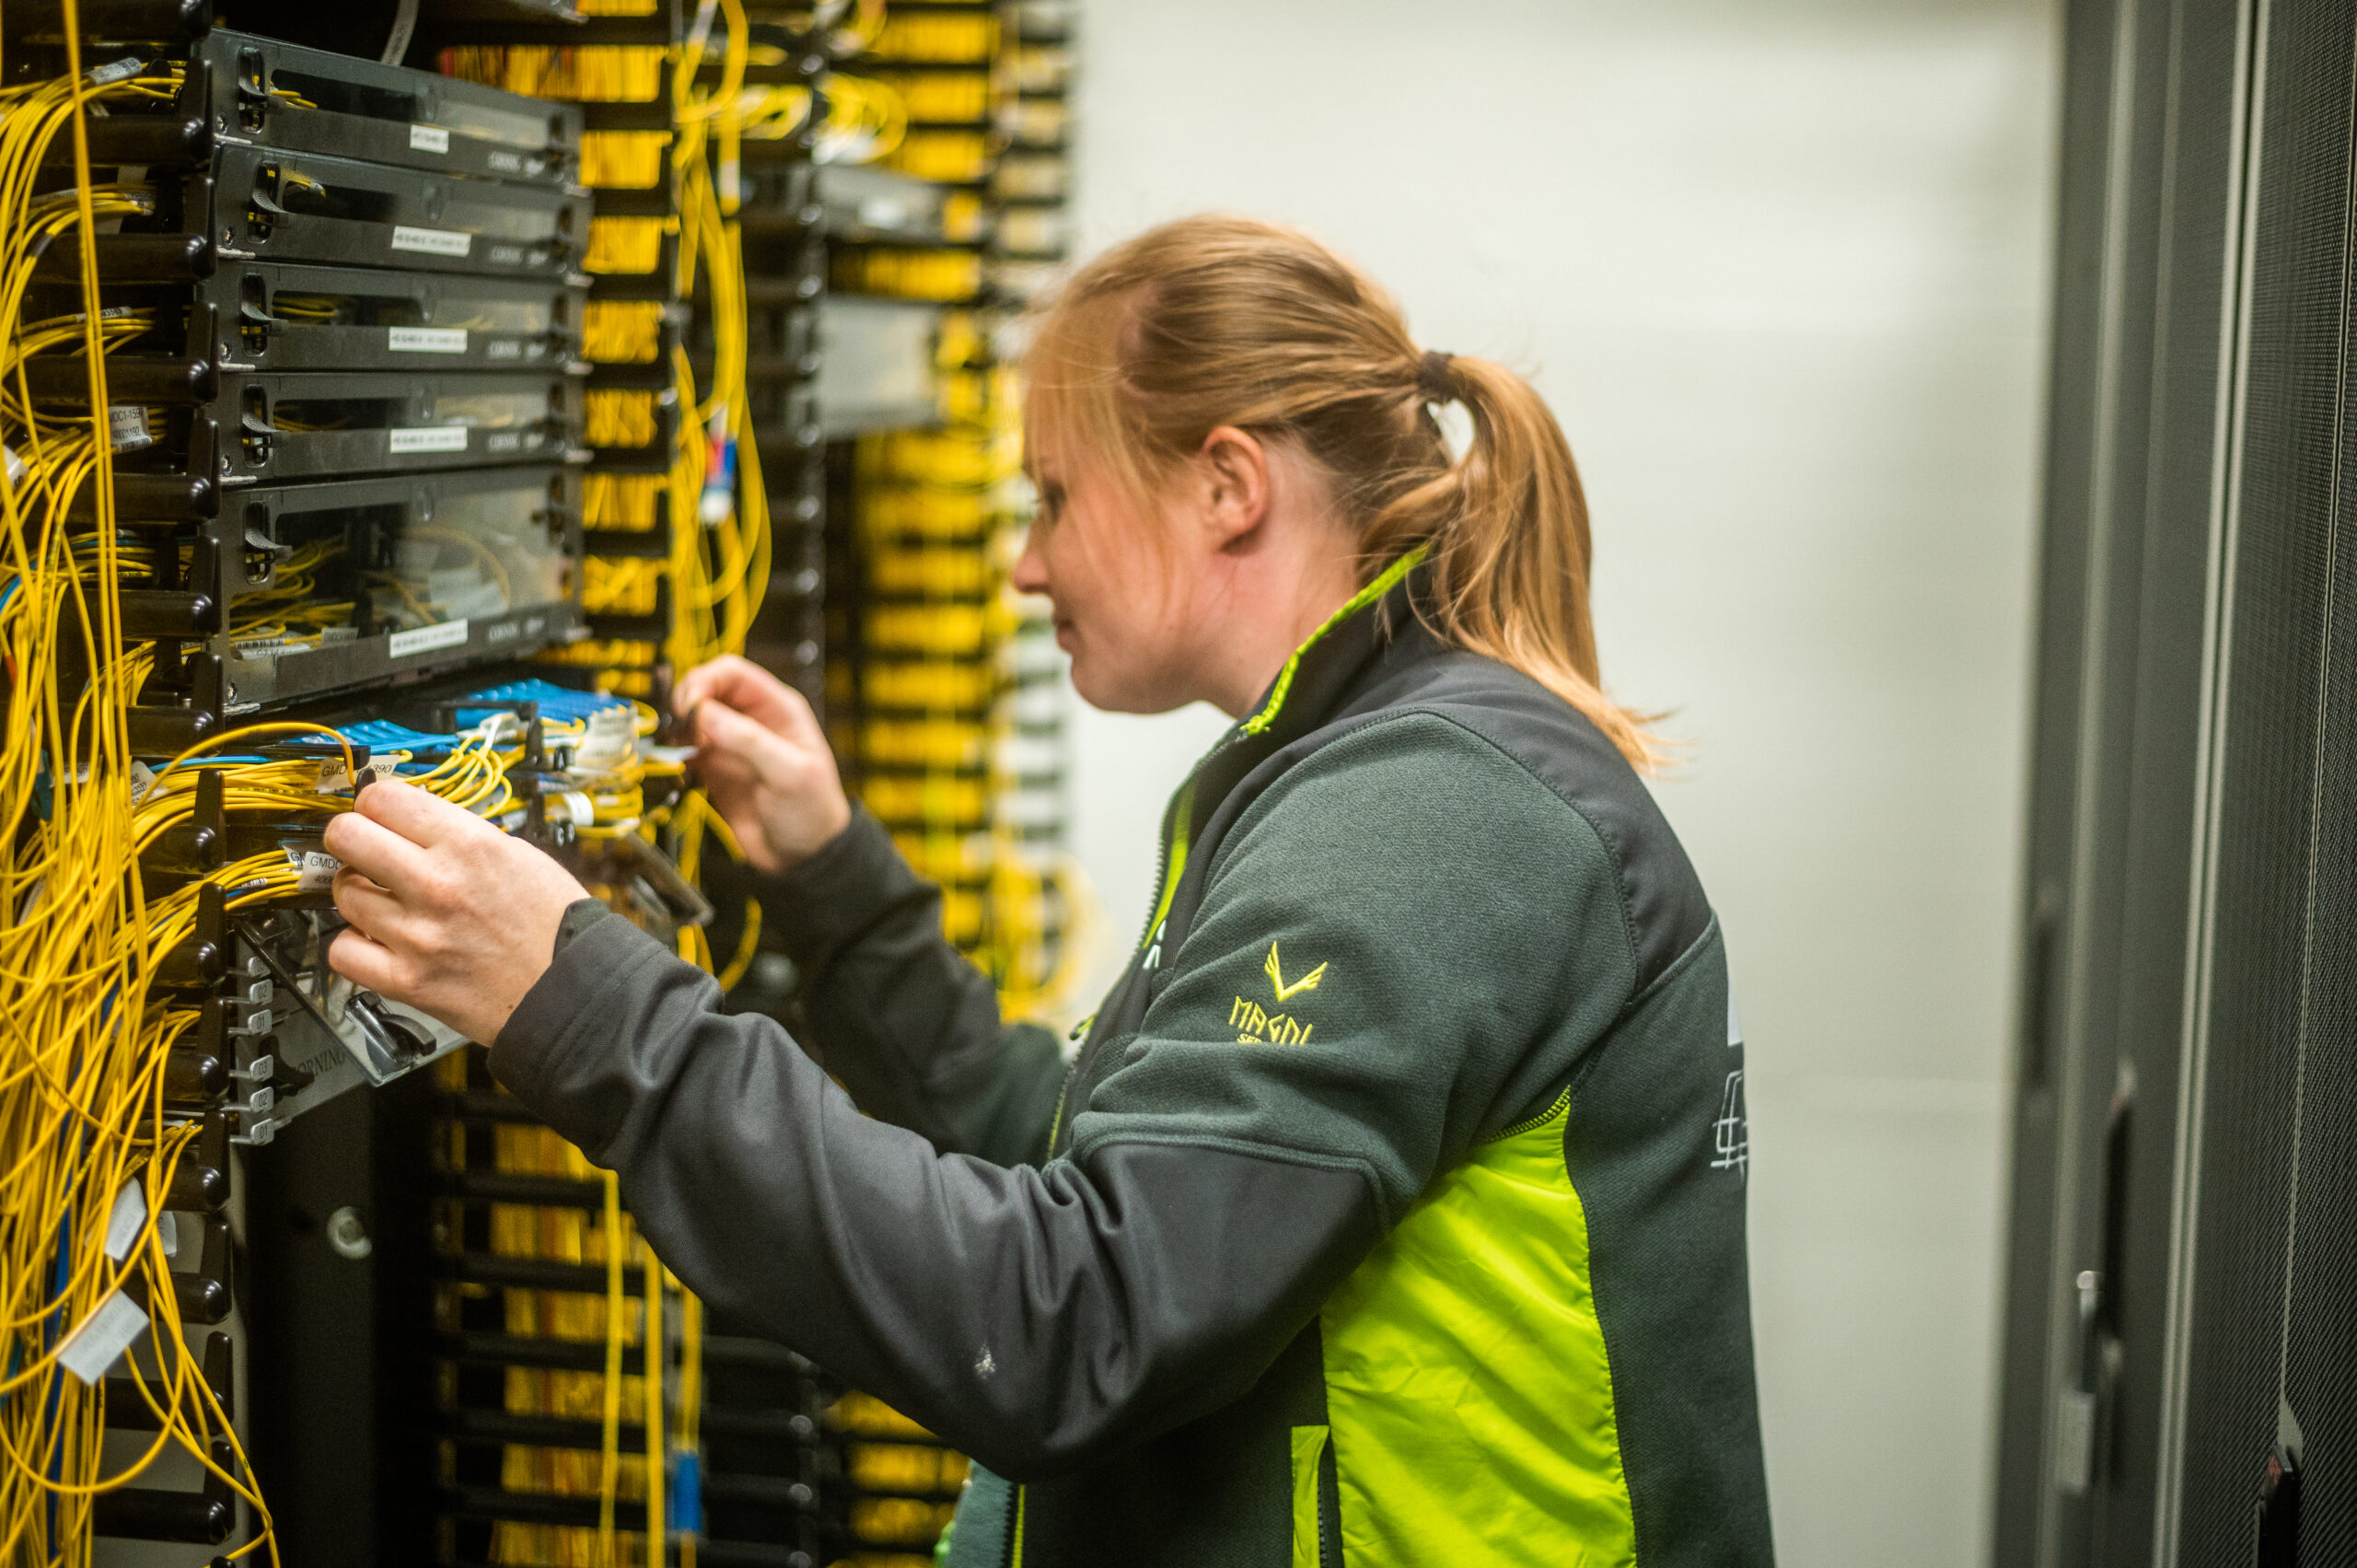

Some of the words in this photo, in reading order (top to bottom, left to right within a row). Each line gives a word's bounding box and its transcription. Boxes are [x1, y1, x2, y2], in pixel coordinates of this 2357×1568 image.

[258, 985, 268, 999] 02
[257, 1016, 265, 1030] 01
[258, 1061, 268, 1075] 03
[258, 1092, 268, 1107] 02
[259, 1124, 268, 1139] 01
